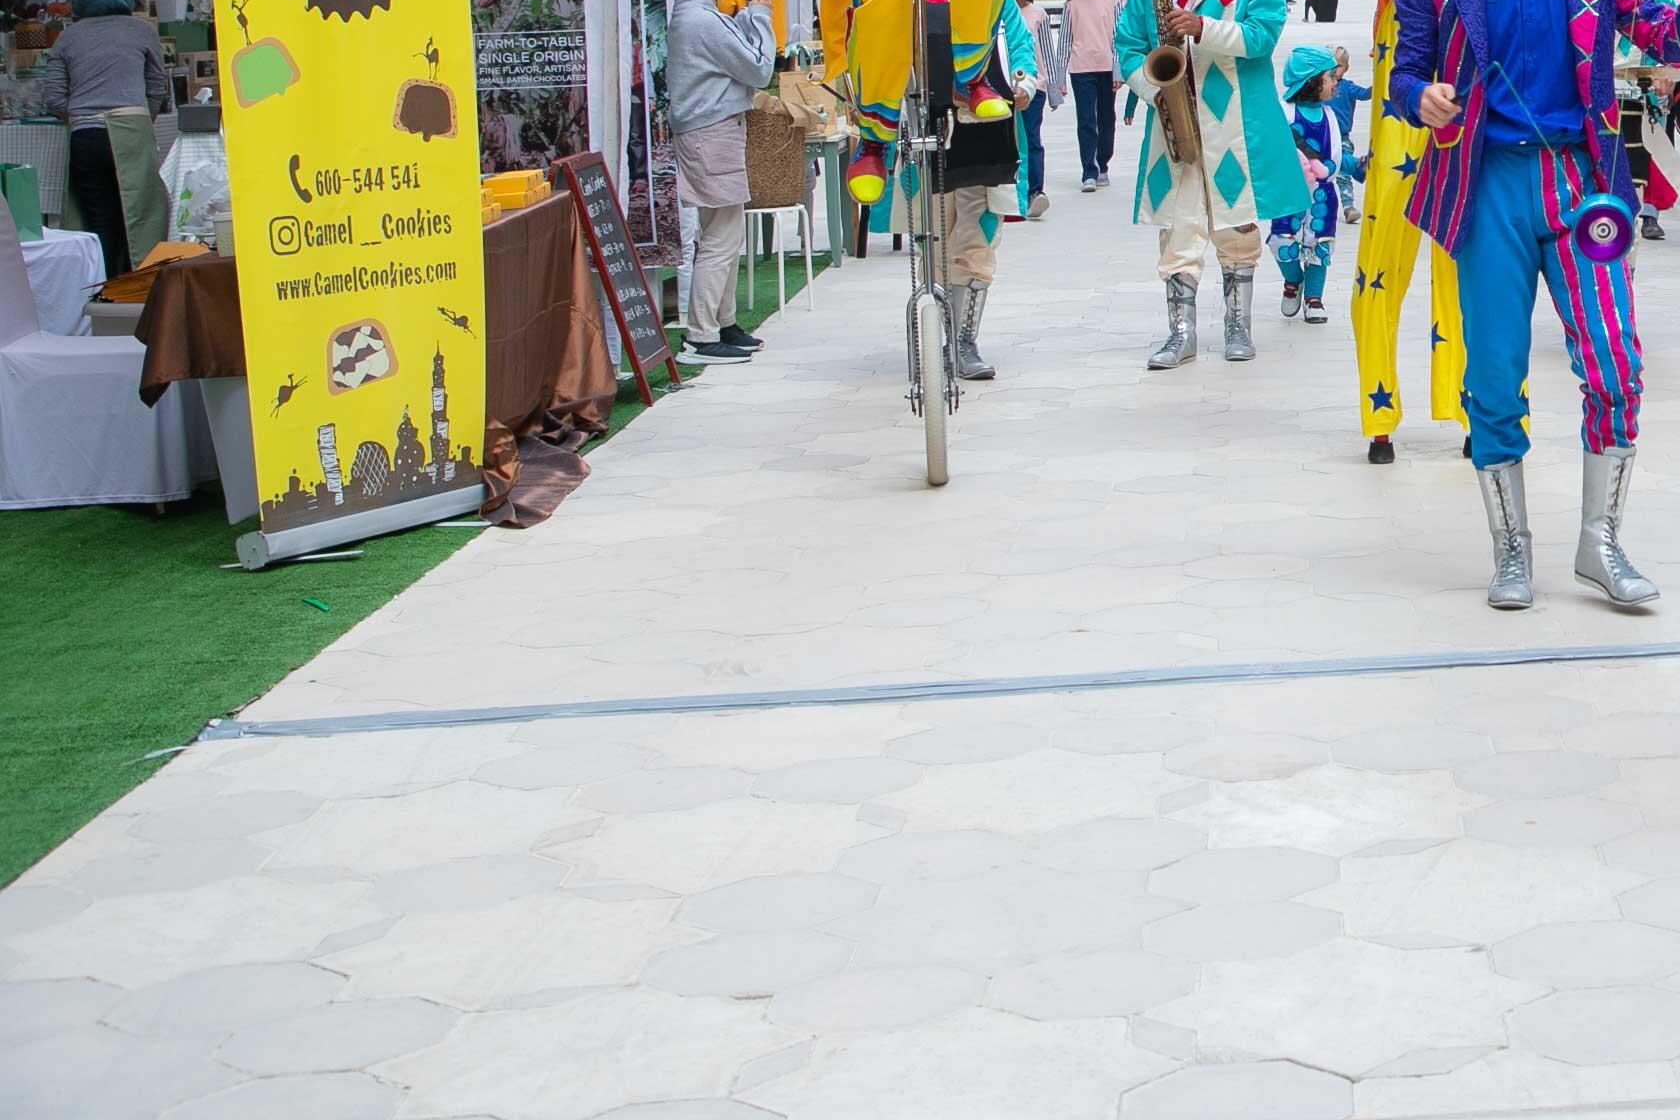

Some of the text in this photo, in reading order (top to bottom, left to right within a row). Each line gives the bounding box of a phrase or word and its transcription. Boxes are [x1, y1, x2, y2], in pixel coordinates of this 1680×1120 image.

[478, 35, 585, 50] FARM-TO-TABLE
[479, 49, 585, 64] SINGLE ORIGIN
[480, 67, 501, 75] FINE
[544, 63, 586, 73] ARTISAN
[480, 74, 587, 85] SMALL BATCH CHOCOLATES
[315, 168, 384, 197] 600-544
[304, 215, 353, 247] Camel
[276, 261, 457, 301] www.CamelCookies.com
